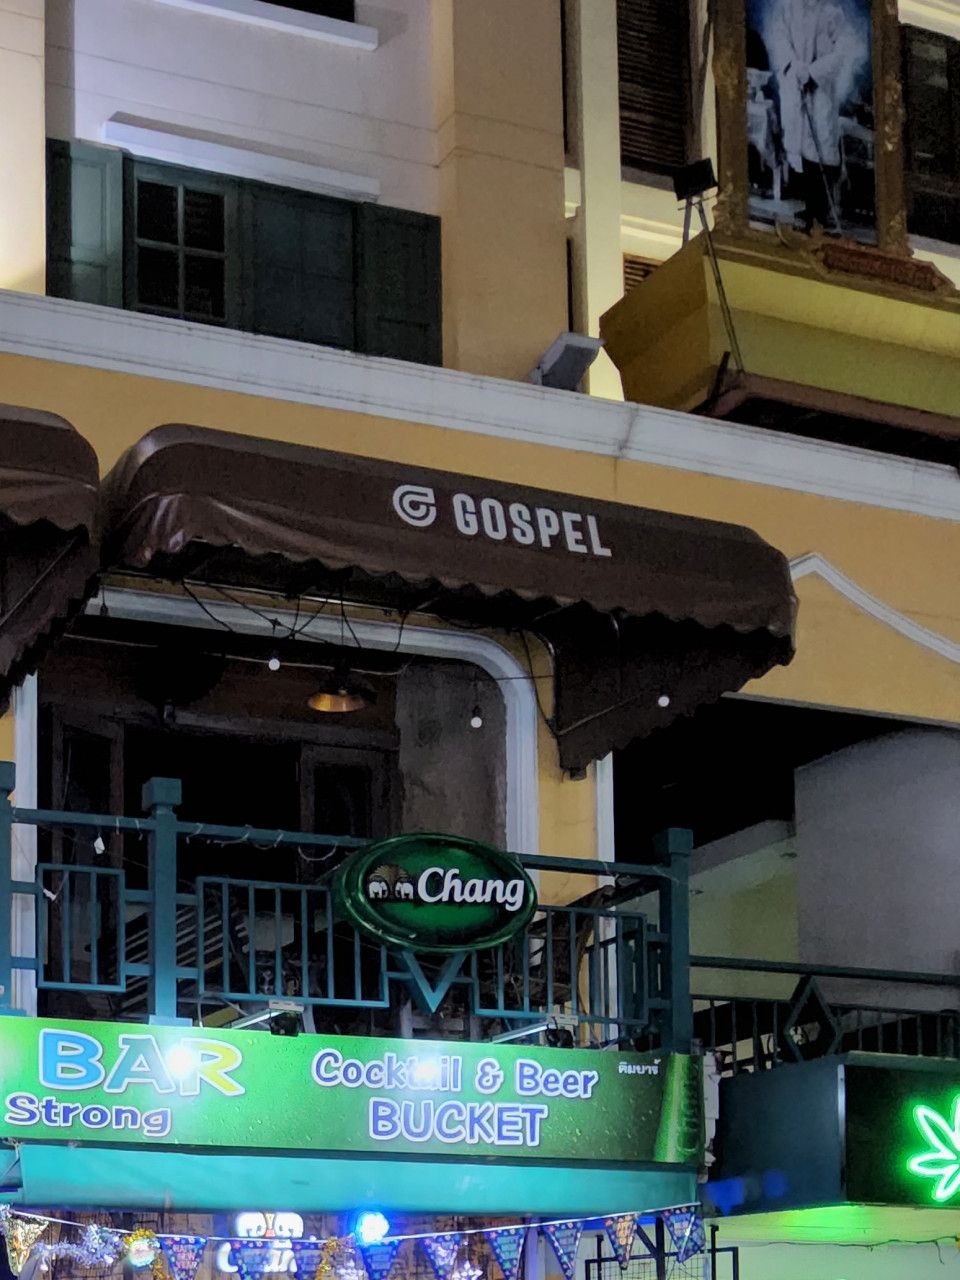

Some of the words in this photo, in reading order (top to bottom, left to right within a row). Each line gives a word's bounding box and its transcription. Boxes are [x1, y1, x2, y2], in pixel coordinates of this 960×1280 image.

[452, 493, 612, 557] GOSPEL
[417, 867, 525, 912] Chang
[39, 1027, 245, 1096] BAR
[474, 1059, 504, 1093] &
[514, 1058, 598, 1099] Beer
[4, 1091, 172, 1137] Strong
[368, 1097, 548, 1146] BUCKET
